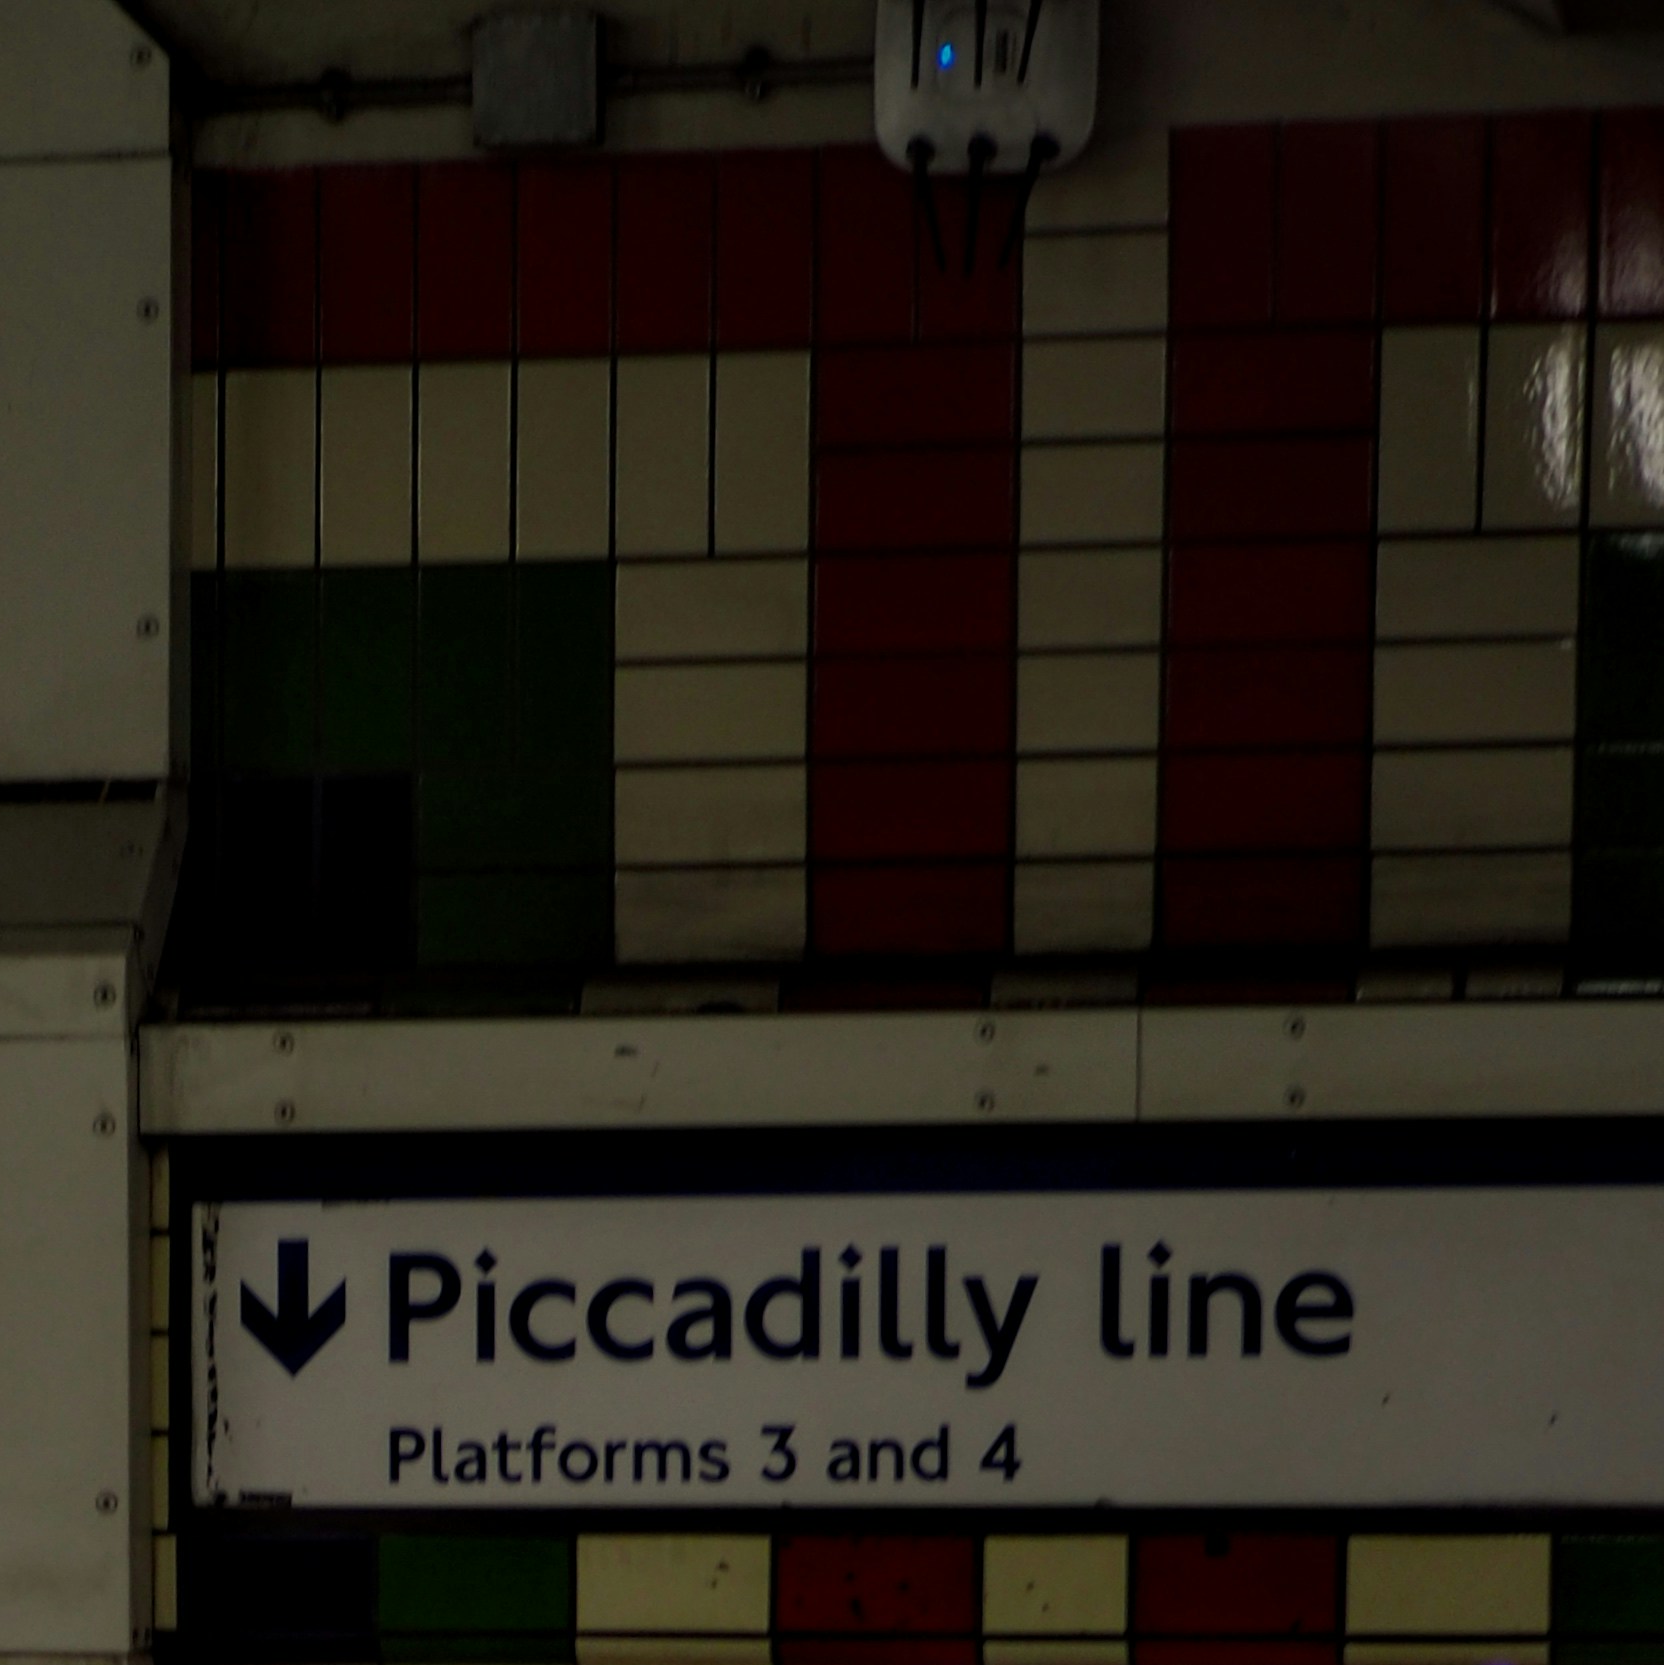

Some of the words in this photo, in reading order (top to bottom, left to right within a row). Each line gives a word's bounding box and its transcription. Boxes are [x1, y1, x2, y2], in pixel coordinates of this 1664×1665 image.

[388, 1244, 1039, 1389] Piccadilly
[1100, 1239, 1354, 1357] line
[388, 1423, 731, 1484] Platforms
[759, 1423, 798, 1483] 3
[826, 1423, 950, 1483] and
[979, 1422, 1022, 1482] 4
